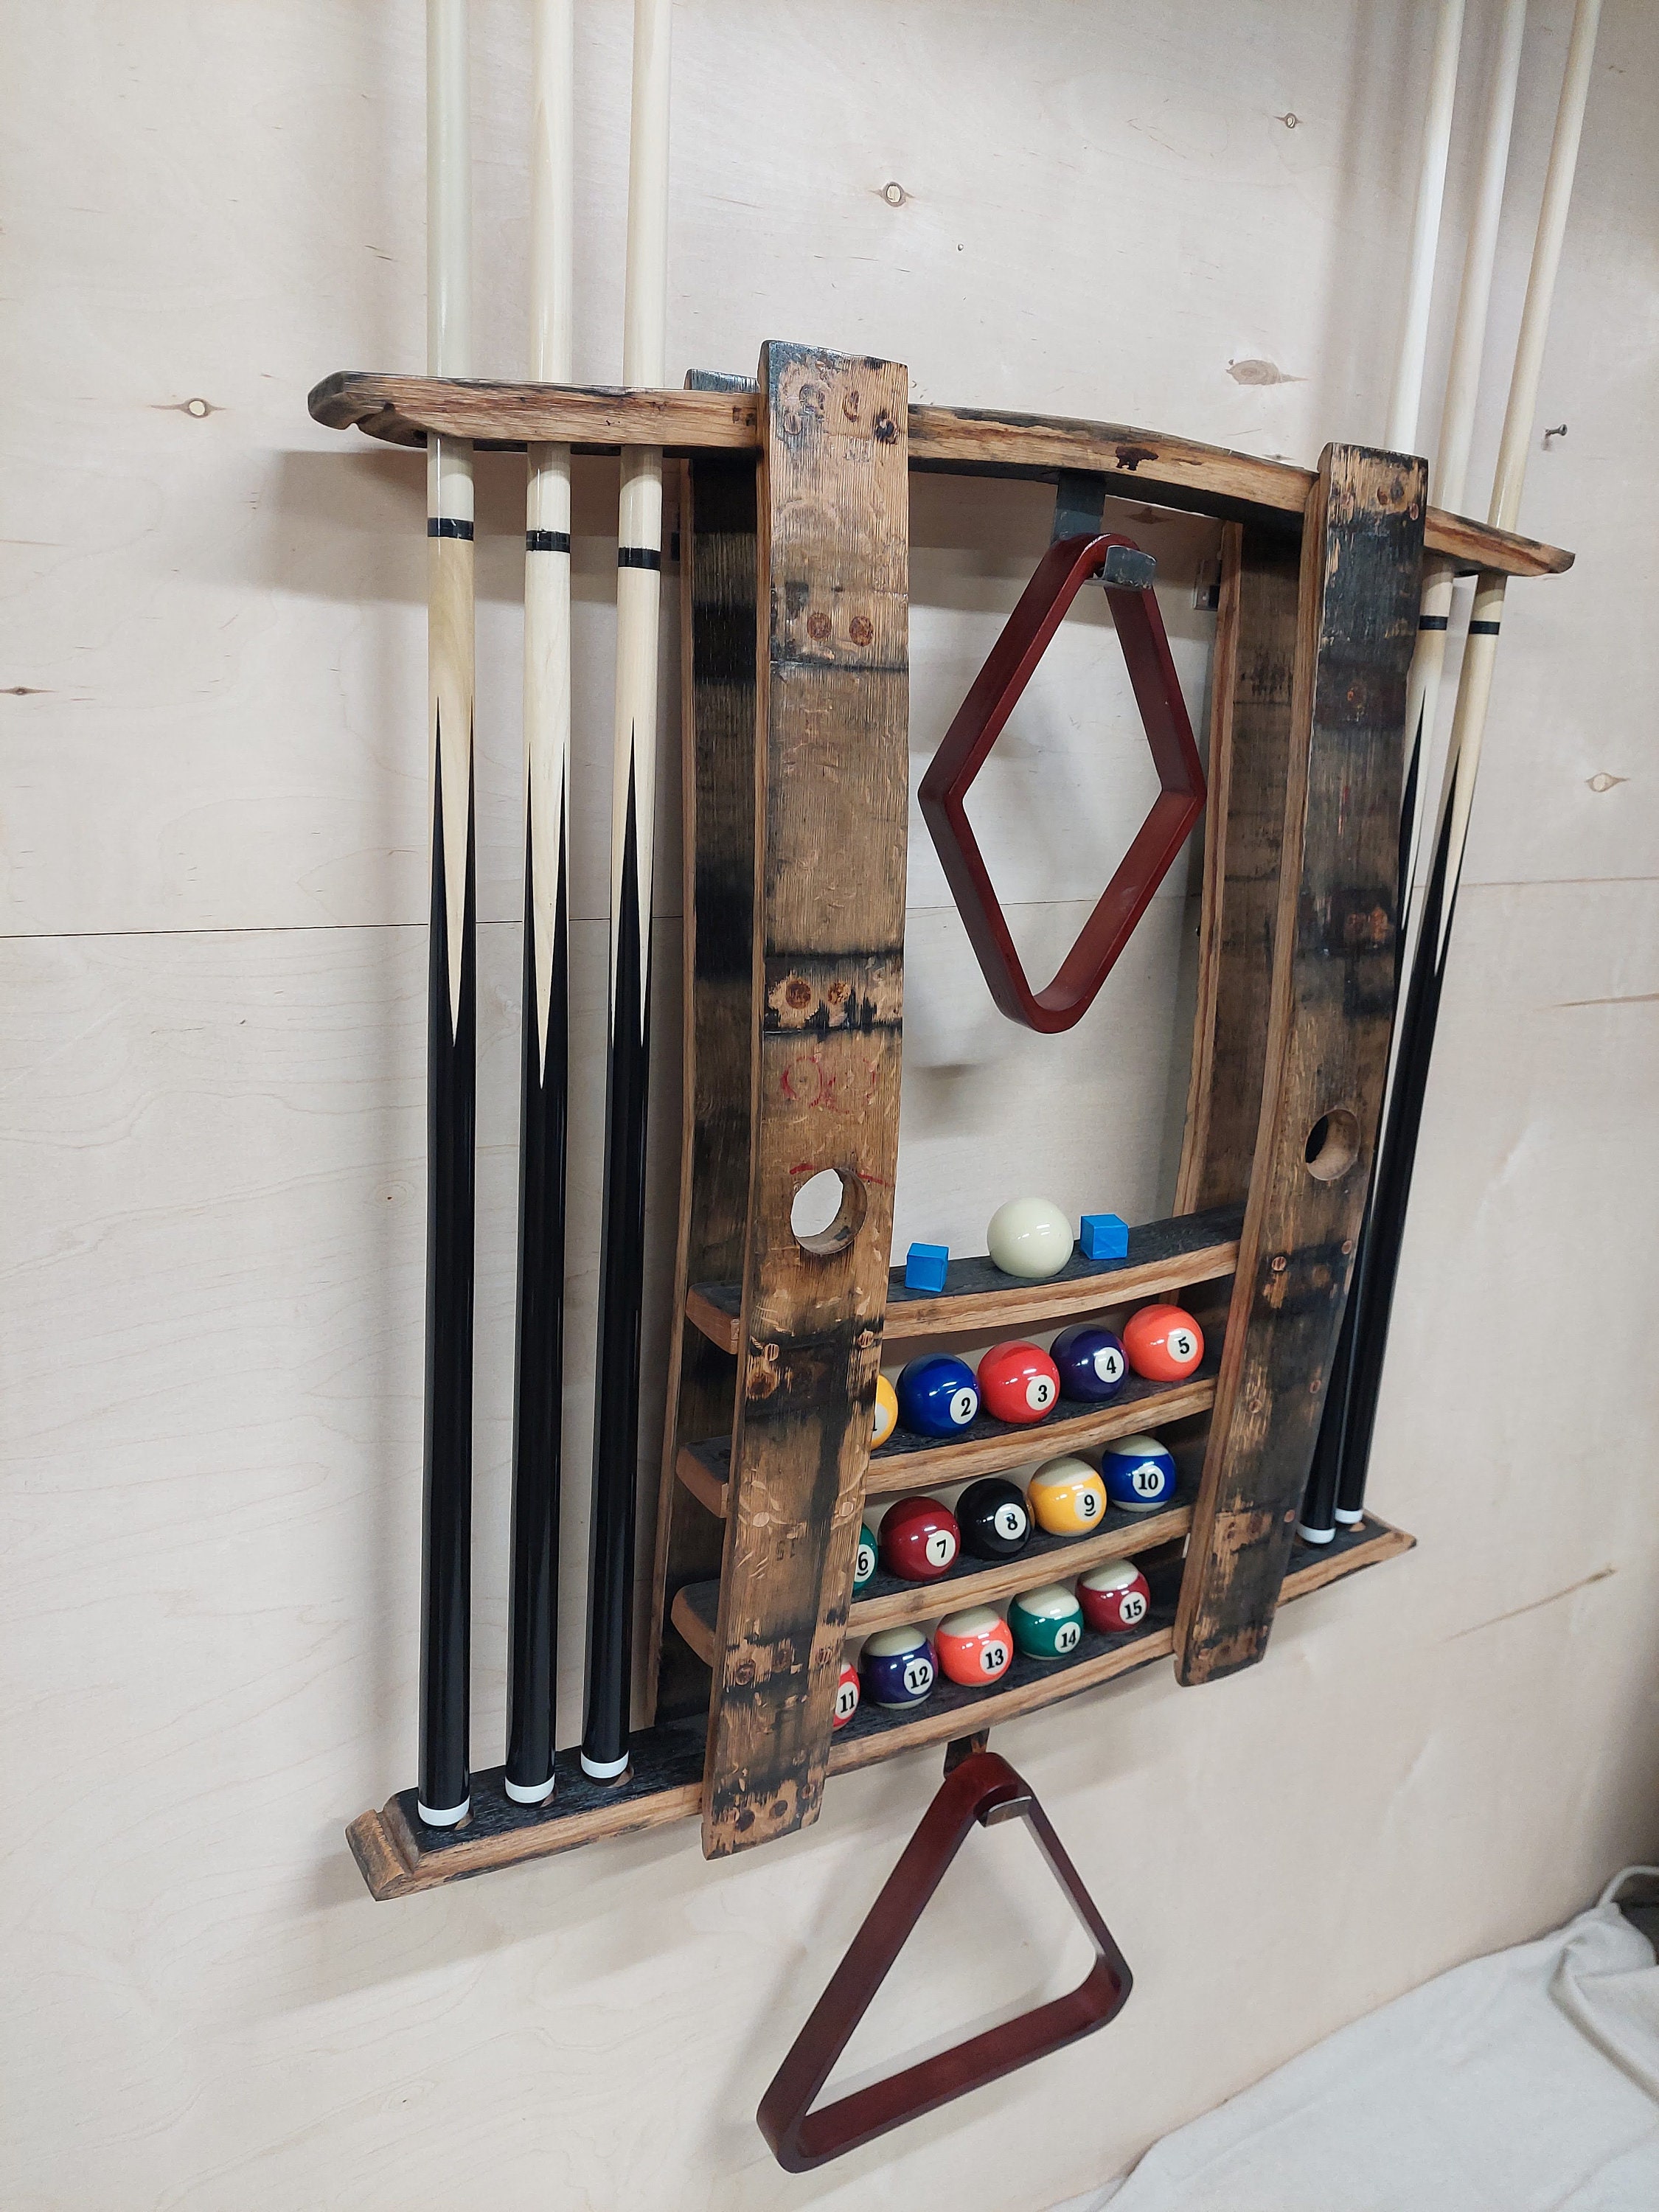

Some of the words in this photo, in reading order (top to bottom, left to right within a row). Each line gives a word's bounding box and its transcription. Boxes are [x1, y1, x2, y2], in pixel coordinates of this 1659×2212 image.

[1178, 1336, 1190, 1354] 5
[1107, 1355, 1117, 1374] 4
[1037, 1384, 1048, 1402] 3
[961, 1397, 972, 1417] 2
[1138, 1473, 1159, 1490] 10
[1085, 1494, 1095, 1512] 9
[1006, 1513, 1018, 1531] 8
[936, 1539, 947, 1559] 7
[858, 1551, 868, 1571] 6
[1124, 1599, 1142, 1620] 15
[1060, 1629, 1077, 1649] 14
[985, 1649, 1004, 1670] 13
[909, 1666, 930, 1689] 12
[841, 1690, 855, 1714] 11
